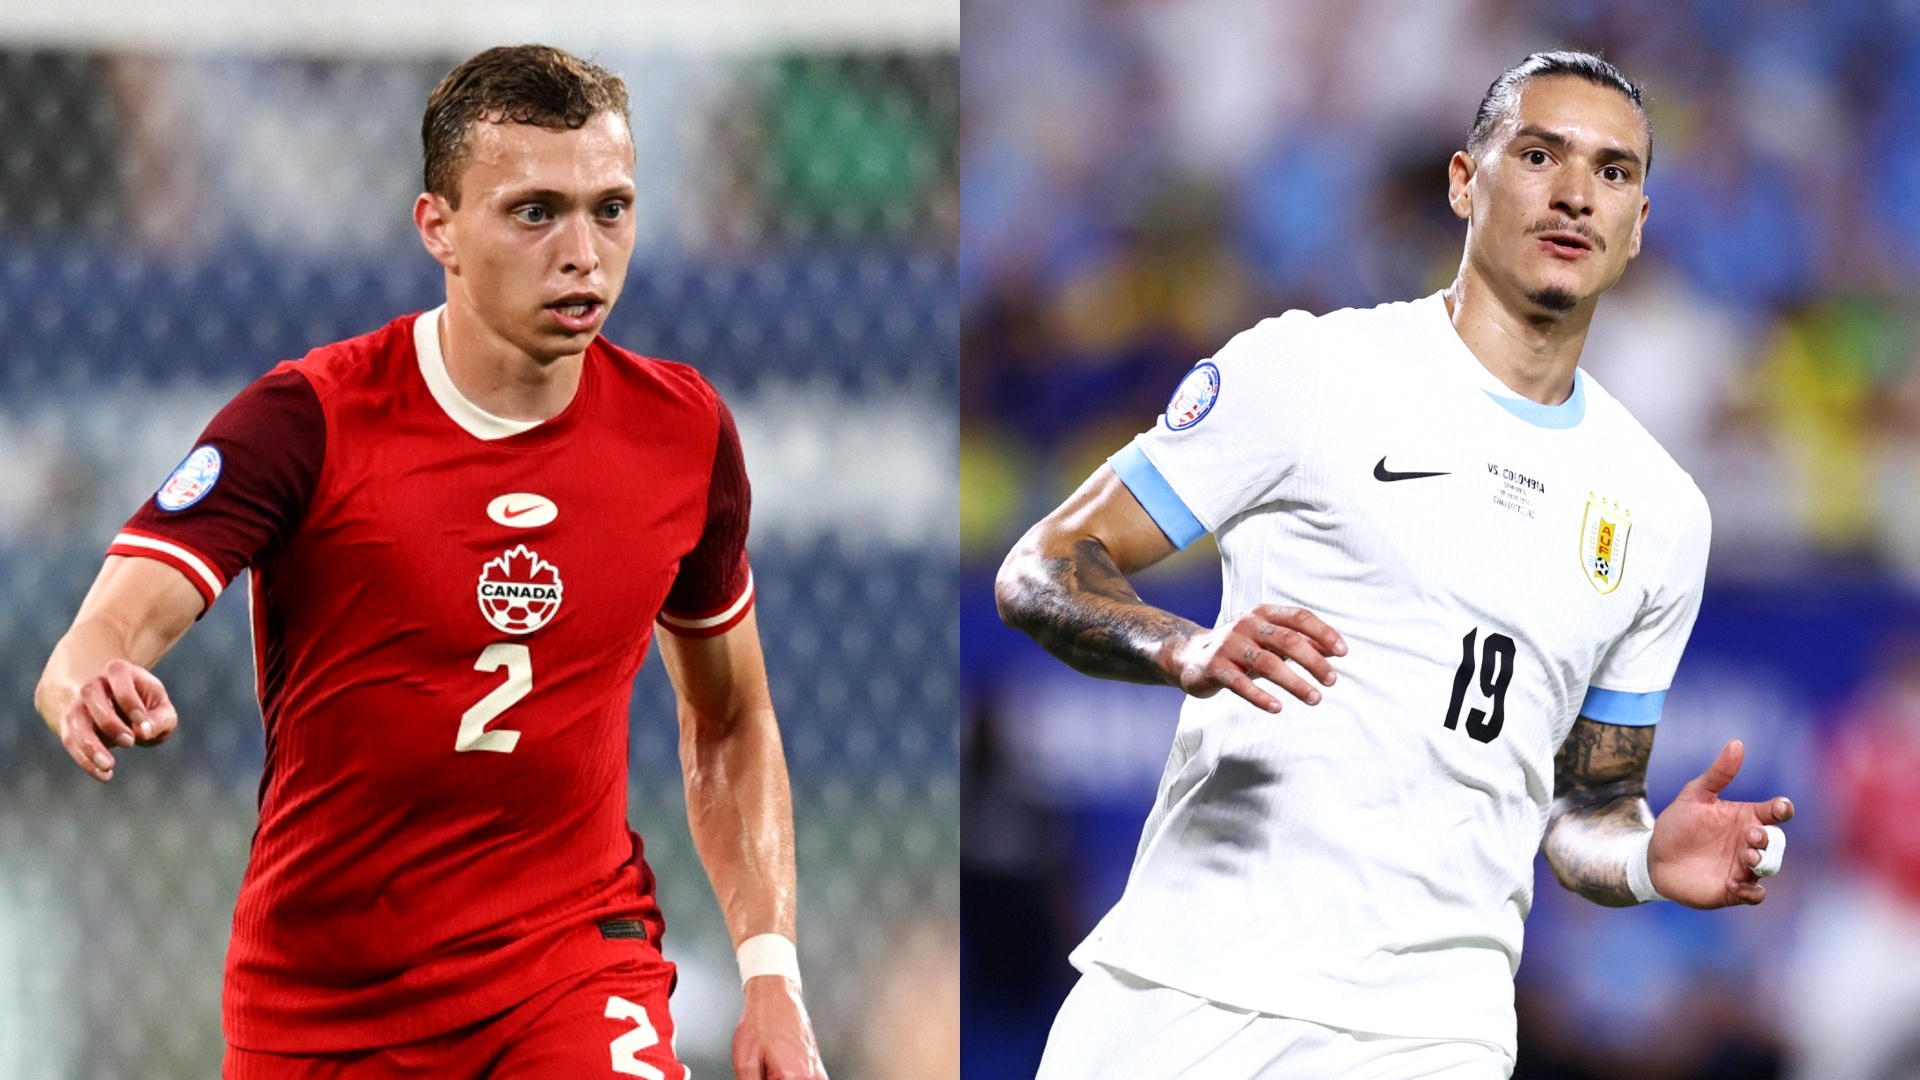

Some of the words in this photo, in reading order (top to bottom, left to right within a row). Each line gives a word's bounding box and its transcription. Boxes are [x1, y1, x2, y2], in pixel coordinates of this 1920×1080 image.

[1487, 462, 1501, 476] VS.
[1503, 469, 1545, 494] COLOMBIA
[481, 584, 558, 600] CANADA
[455, 643, 533, 754] 2
[1443, 626, 1516, 744] 19
[604, 996, 665, 1080] 2
